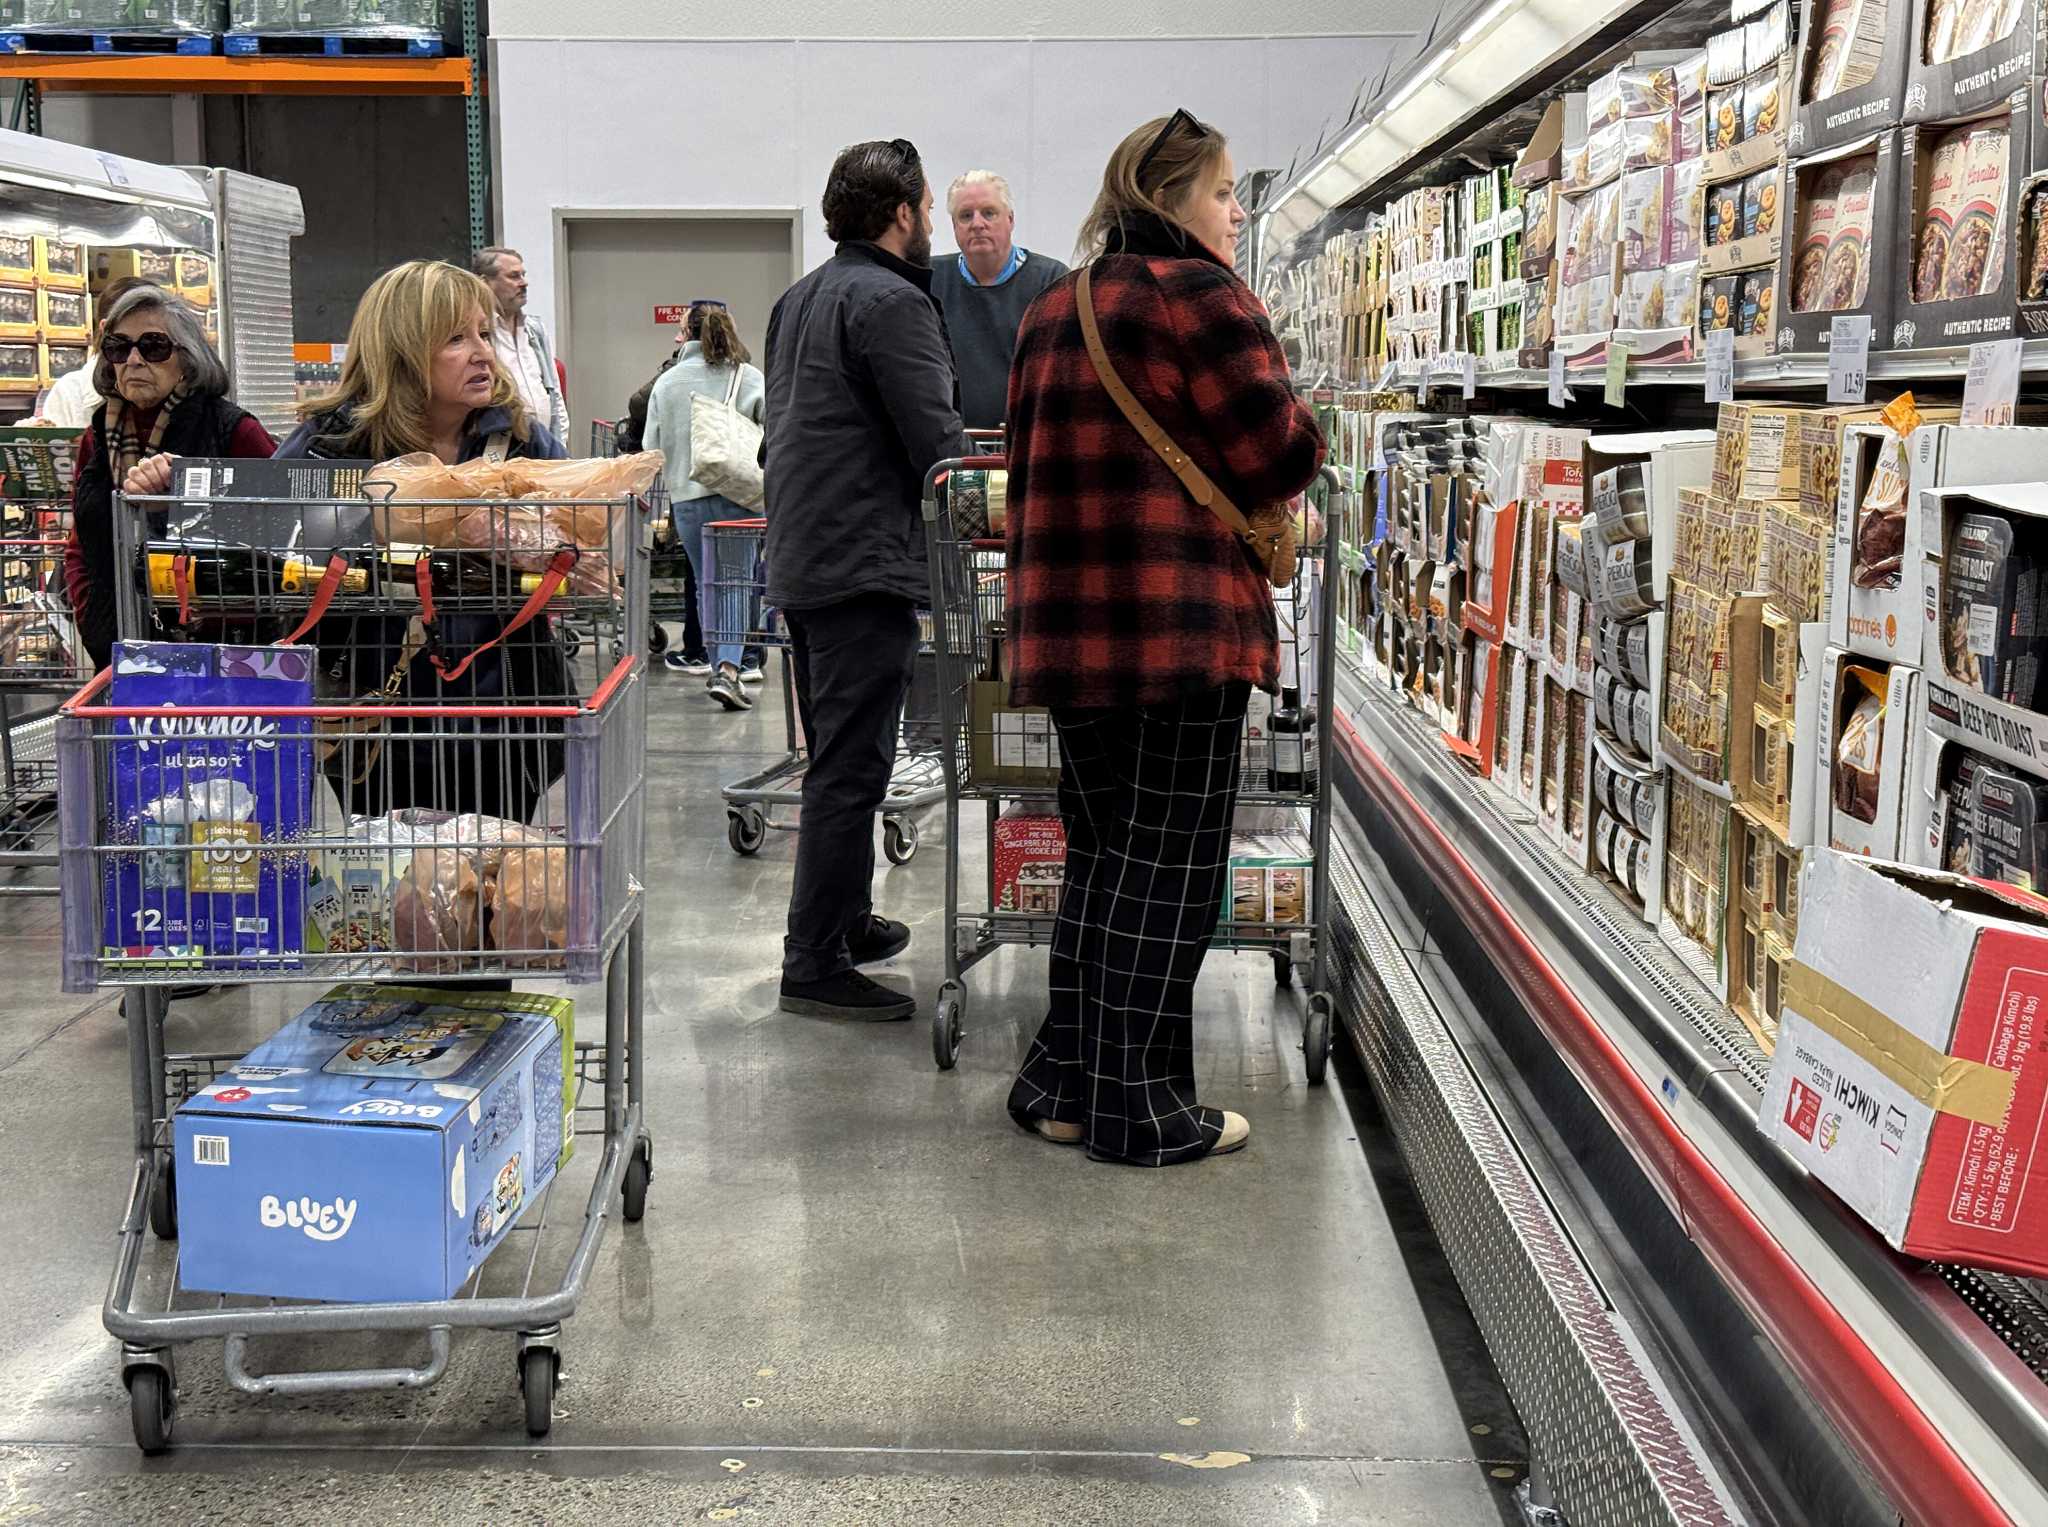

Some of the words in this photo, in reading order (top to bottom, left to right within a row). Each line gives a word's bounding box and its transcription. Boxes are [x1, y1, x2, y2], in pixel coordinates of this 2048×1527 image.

[1999, 52, 2033, 79] RECIPE
[1826, 107, 1861, 130] AUTHENTIC
[1862, 98, 1890, 117] RECIPE
[1943, 319, 1982, 336] AUTHENTIC
[1983, 316, 2011, 333] RECIPE
[1961, 698, 1982, 735] BEEF
[1981, 708, 2002, 745] POT
[2000, 716, 2037, 759] ROAST
[201, 837, 252, 864] 100
[131, 908, 162, 932] 12
[2022, 994, 2042, 1016] lbs)
[2016, 1014, 2035, 1042] (19.8
[1991, 1025, 2015, 1068] Cabbage
[2011, 1053, 2025, 1063] 9
[2013, 1039, 2032, 1056] kg
[338, 1099, 444, 1118] BLUEY
[1833, 1074, 1881, 1129] KIMCHI
[1973, 1124, 1991, 1140] kg
[1971, 1138, 1986, 1155] 1.5
[1987, 1133, 2006, 1161] (52.9
[1963, 1153, 1982, 1187] Kimchi
[1982, 1158, 2000, 1174] kg
[1995, 1151, 2018, 1194] BEFORE
[1979, 1172, 1994, 1190] 1.5
[1955, 1190, 1973, 1217] ITEM
[1987, 1193, 2007, 1222] BEST
[260, 1195, 358, 1242] BLUEY
